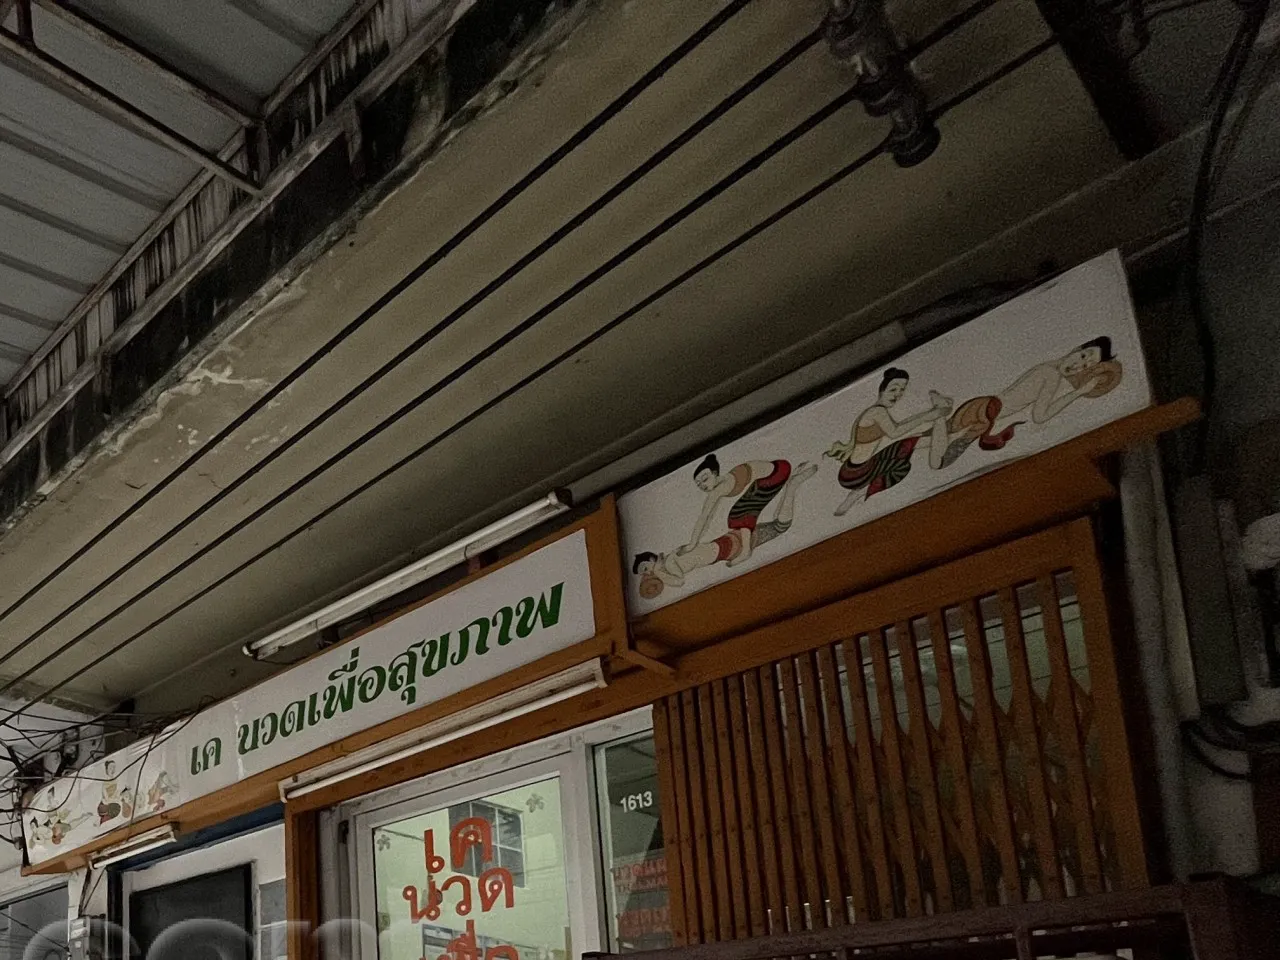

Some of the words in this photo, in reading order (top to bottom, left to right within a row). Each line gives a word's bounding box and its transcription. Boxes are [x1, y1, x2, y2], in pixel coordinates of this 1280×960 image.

[190, 737, 222, 776] เค
[237, 581, 565, 756] นวดเพื่อสุขภาพ
[620, 791, 653, 813] 1613
[423, 816, 494, 874] เค
[402, 866, 515, 924] นวด
